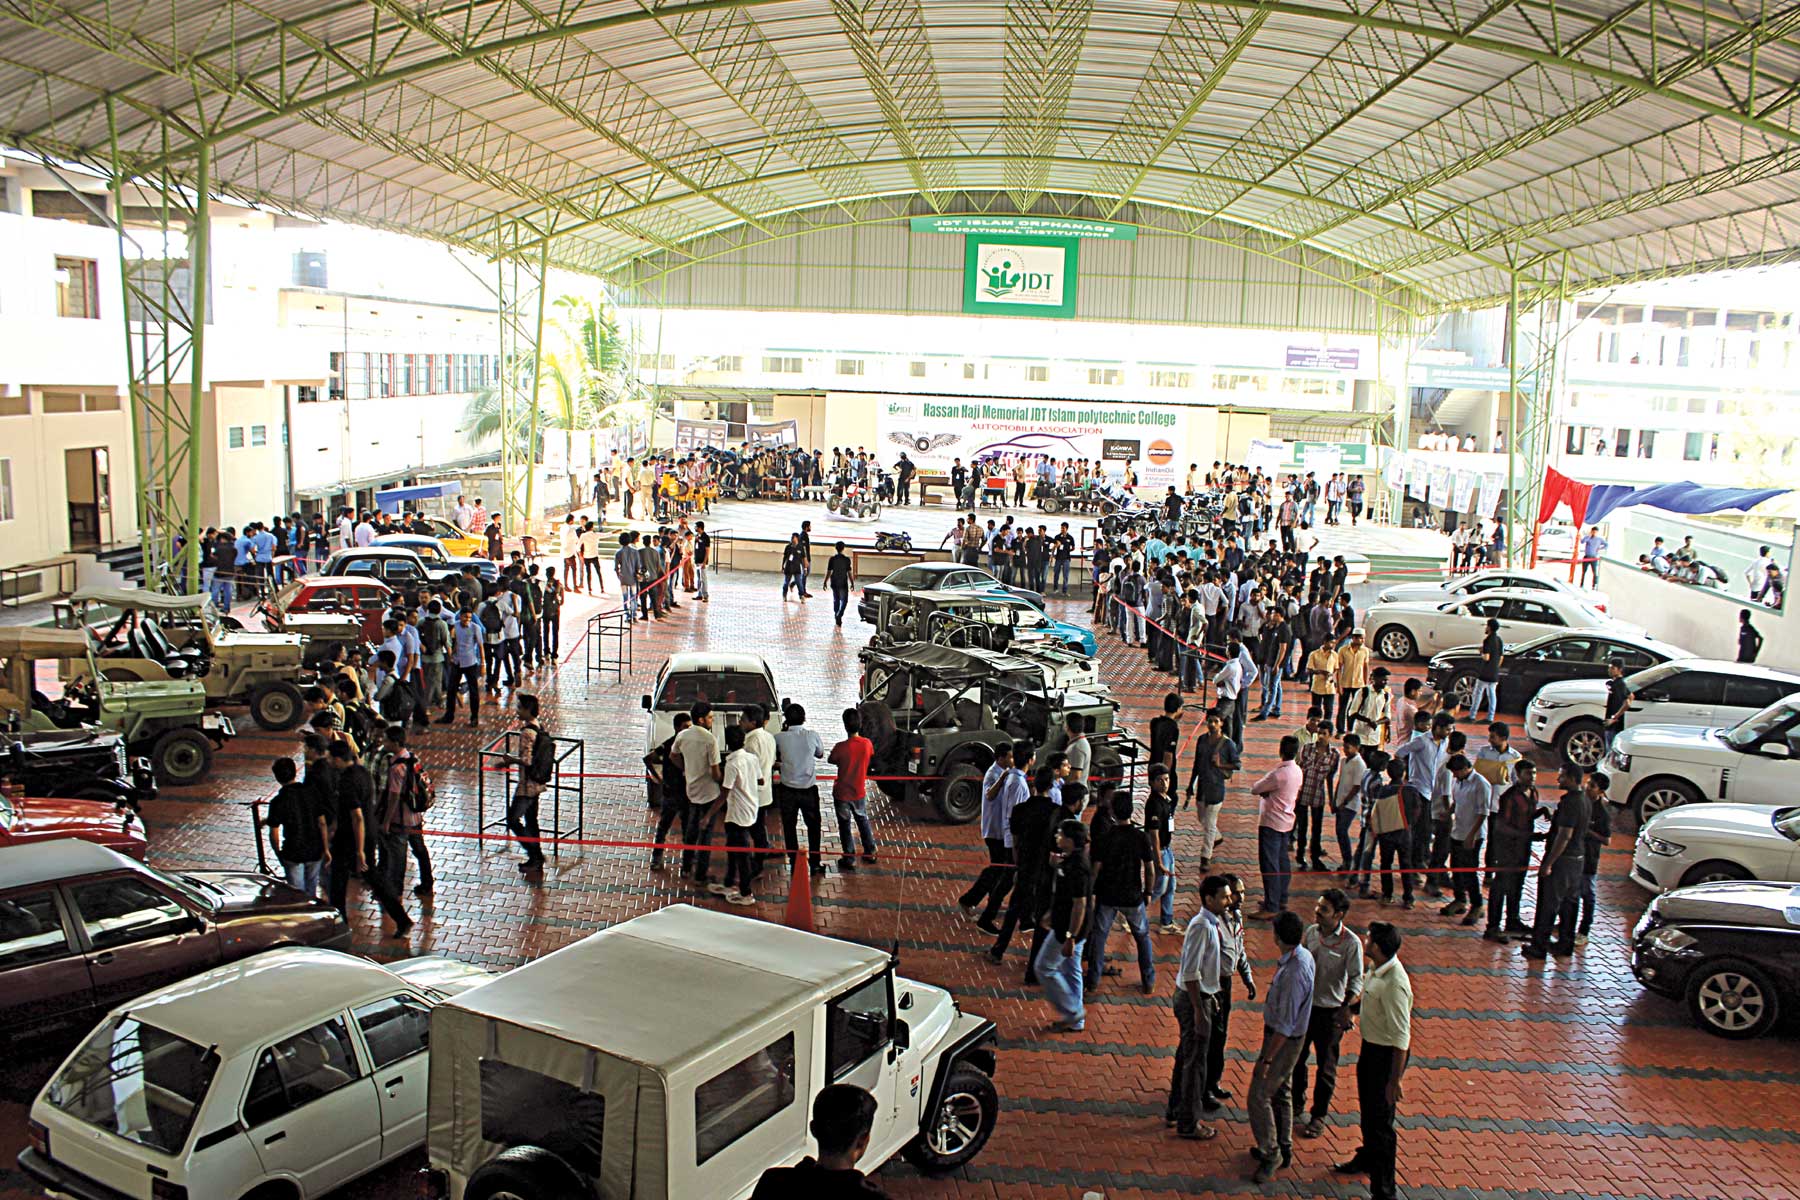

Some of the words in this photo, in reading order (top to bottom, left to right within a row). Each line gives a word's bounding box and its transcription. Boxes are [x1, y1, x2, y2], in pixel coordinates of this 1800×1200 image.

[937, 226, 1022, 234] EDUCATIONAL
[1026, 229, 1110, 238] INSTITUTIONS
[1018, 220, 1115, 233] ORPHANAGE
[1020, 272, 1055, 292] JDT
[923, 402, 959, 418] Hassan
[961, 404, 981, 420] Haji
[982, 404, 1029, 421] Memorial
[1030, 407, 1047, 421] JDT
[1048, 407, 1076, 422] Islam
[1077, 409, 1136, 425] polytechnic
[1138, 410, 1176, 427] College
[970, 423, 1035, 433] AUTOMOBILE
[1038, 426, 1103, 434] ASSOCIATION
